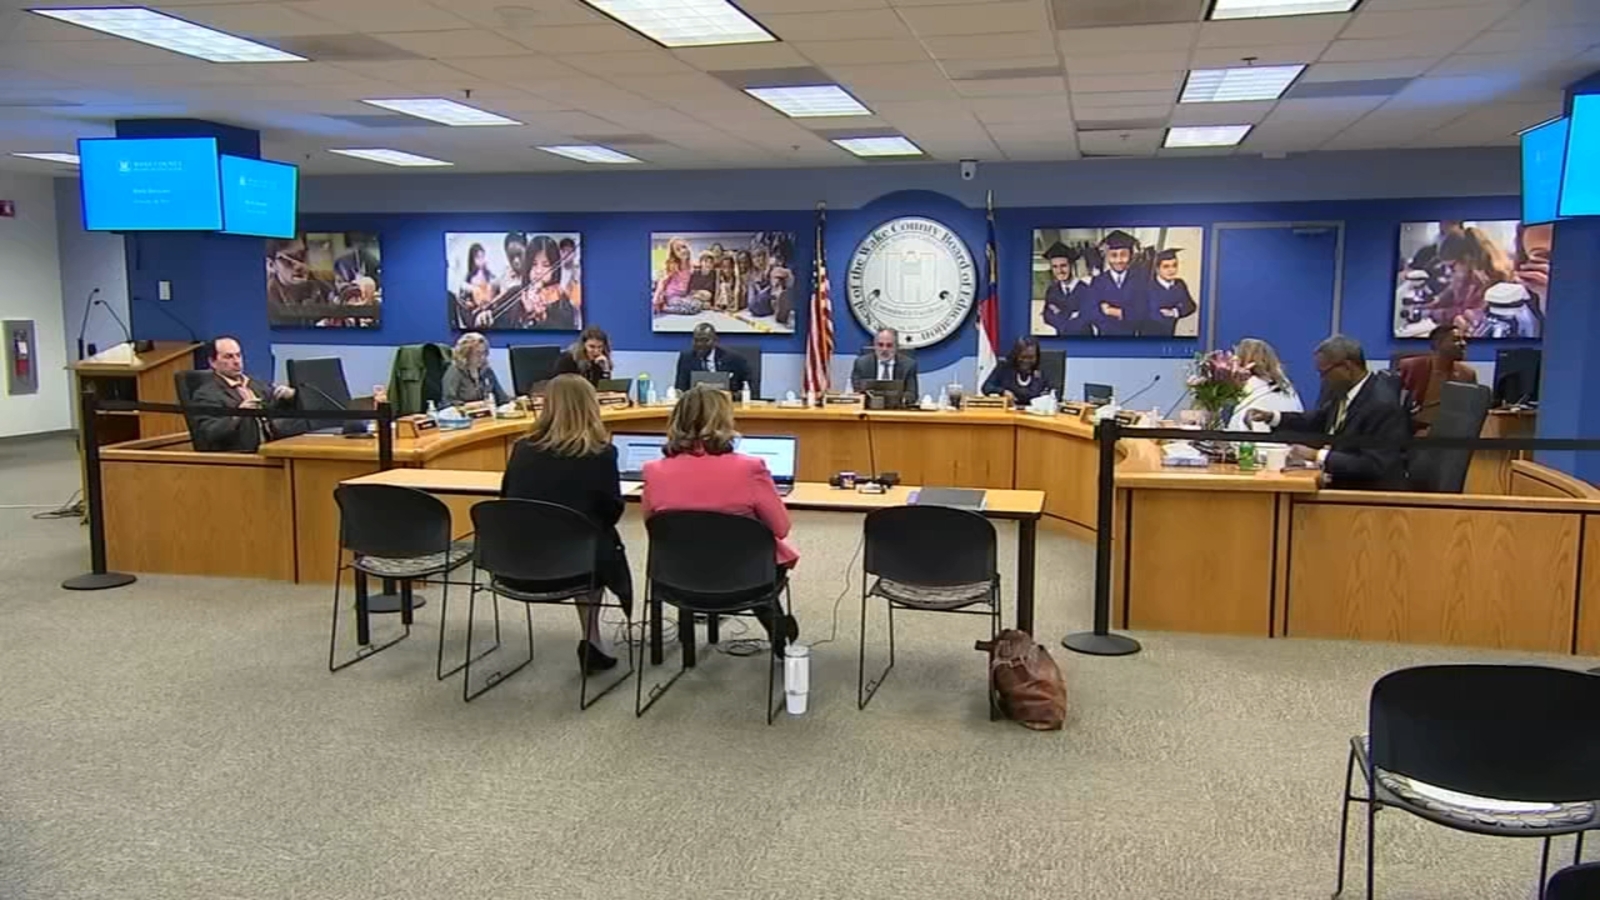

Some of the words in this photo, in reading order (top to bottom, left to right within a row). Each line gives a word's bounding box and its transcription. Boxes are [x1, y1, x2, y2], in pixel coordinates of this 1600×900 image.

[891, 222, 940, 235] County
[860, 229, 890, 255] Wake
[942, 232, 971, 270] Board
[850, 261, 864, 280] the
[961, 273, 971, 286] of
[851, 285, 861, 299] of
[920, 291, 971, 341] Education
